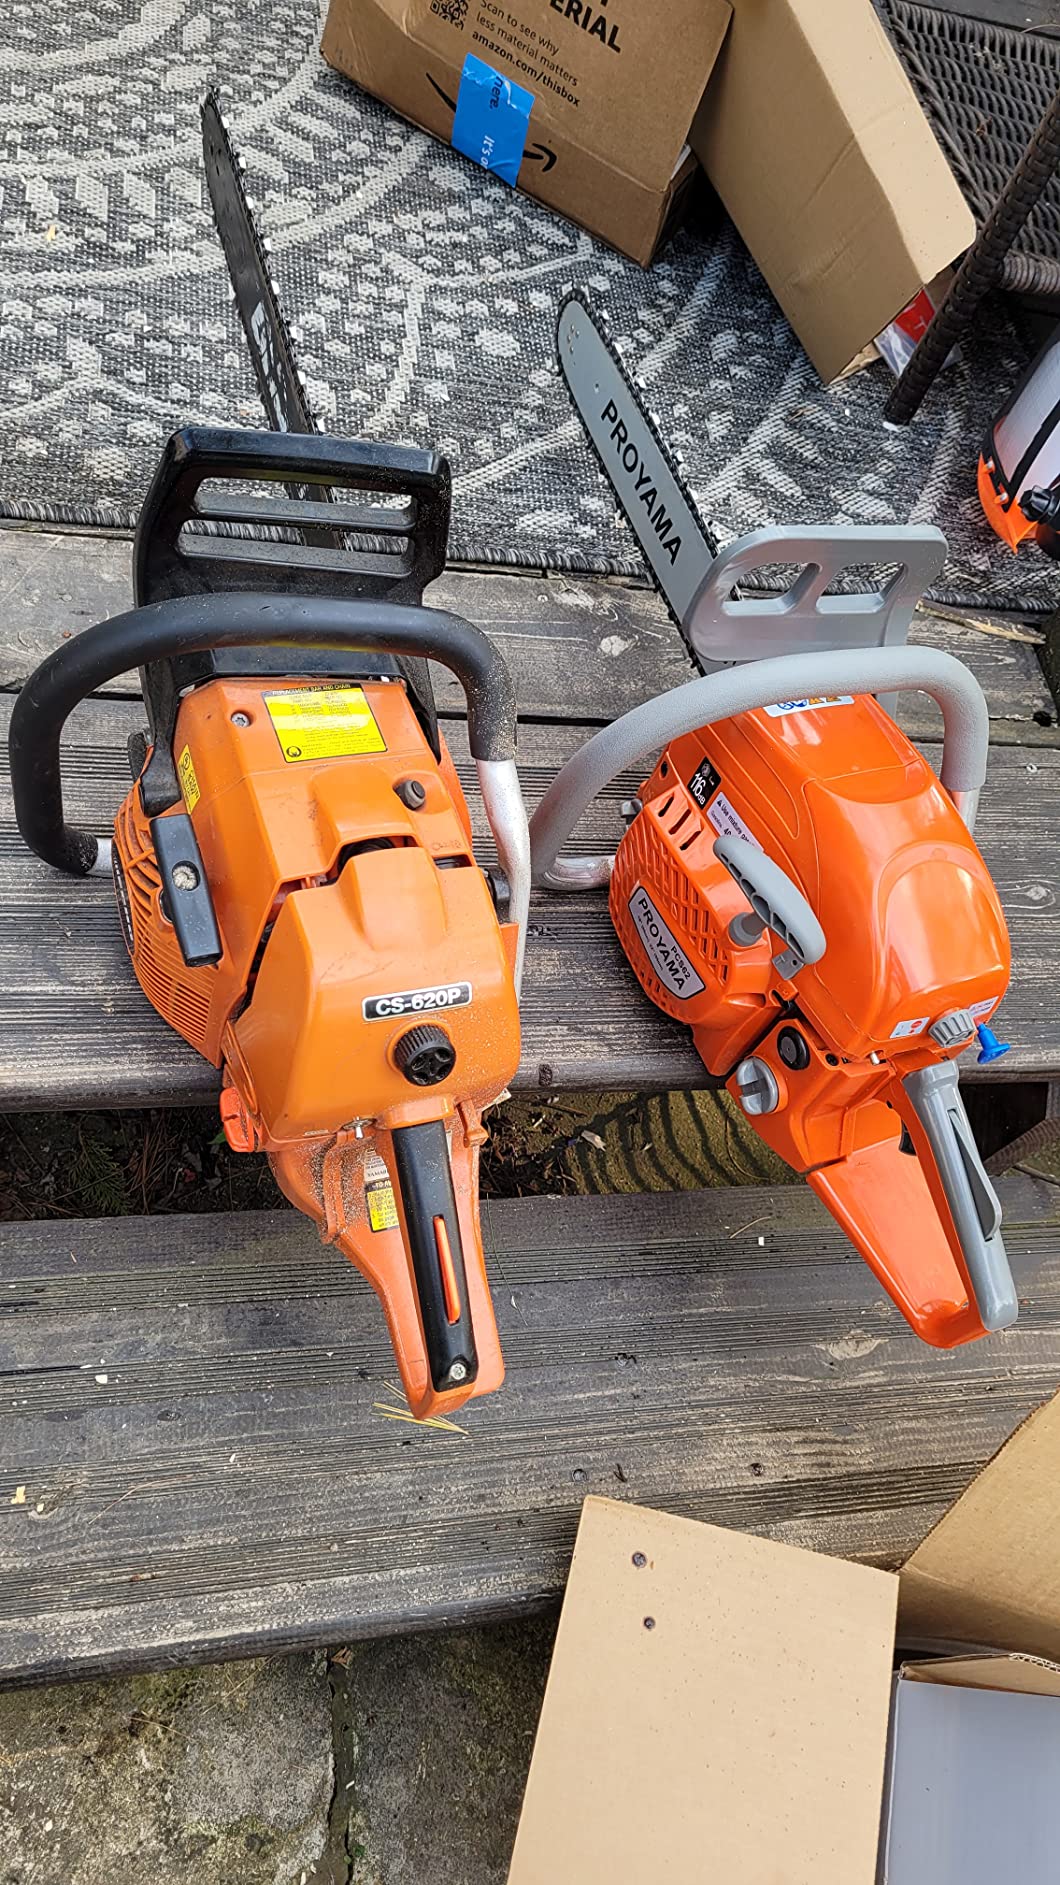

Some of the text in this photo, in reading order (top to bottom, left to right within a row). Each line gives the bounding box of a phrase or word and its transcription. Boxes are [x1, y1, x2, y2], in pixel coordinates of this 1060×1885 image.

[476, 11, 578, 87] less material matters
[480, 0, 559, 57] Scan to see why
[472, 30, 580, 107] amazon.com/thisbox
[601, 399, 682, 566] PROYAMA
[638, 898, 686, 990] PROYAMA
[671, 945, 691, 980] PCS62
[375, 988, 461, 1016] CS-620P
